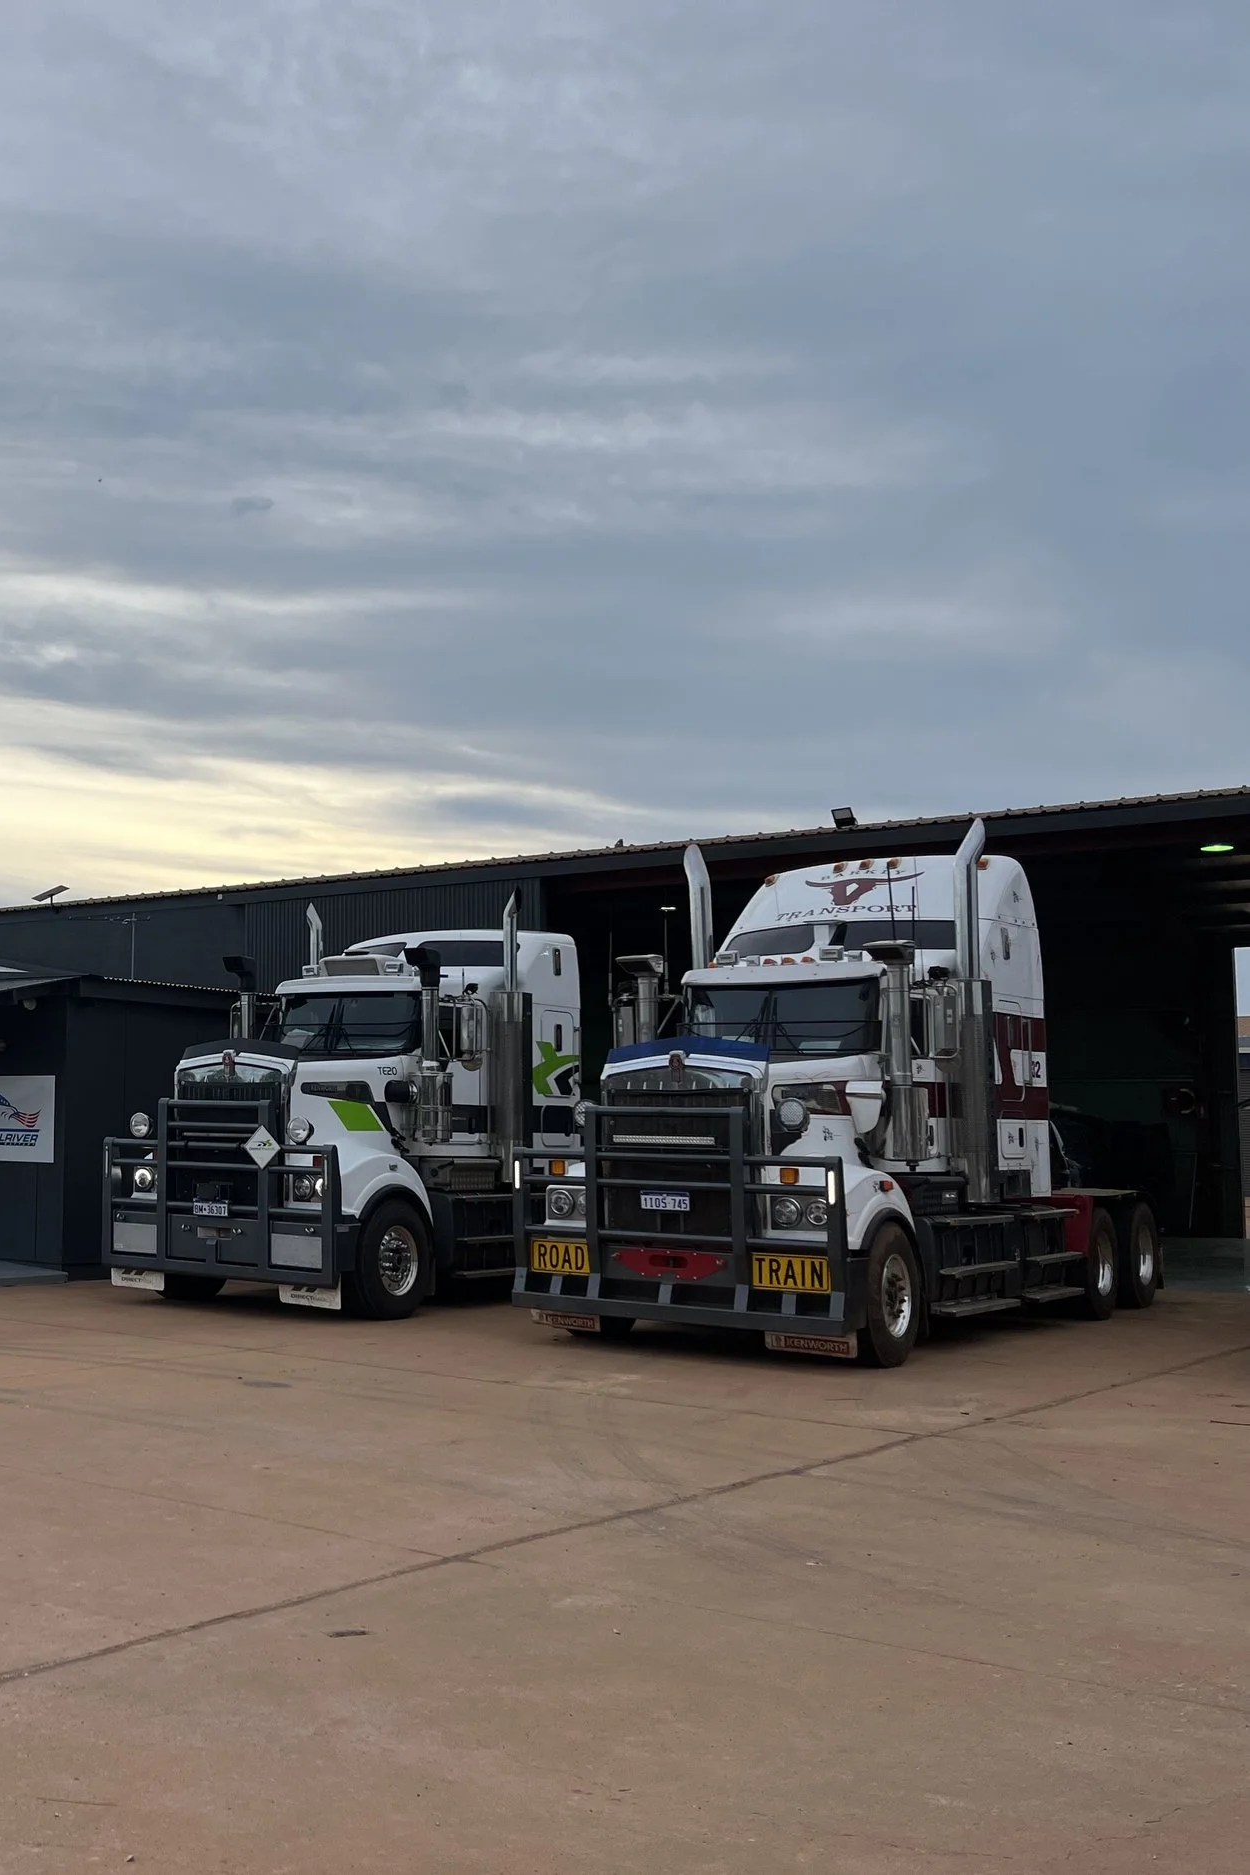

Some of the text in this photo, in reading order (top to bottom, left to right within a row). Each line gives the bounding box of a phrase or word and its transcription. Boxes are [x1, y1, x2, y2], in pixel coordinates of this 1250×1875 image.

[775, 904, 917, 922] TRANSPORT
[377, 1066, 398, 1076] TE20
[538, 1243, 585, 1271] ROAD
[754, 1257, 824, 1288] TRAIN
[547, 1314, 595, 1328] KENWORTH
[786, 1336, 848, 1353] KENWORTH
